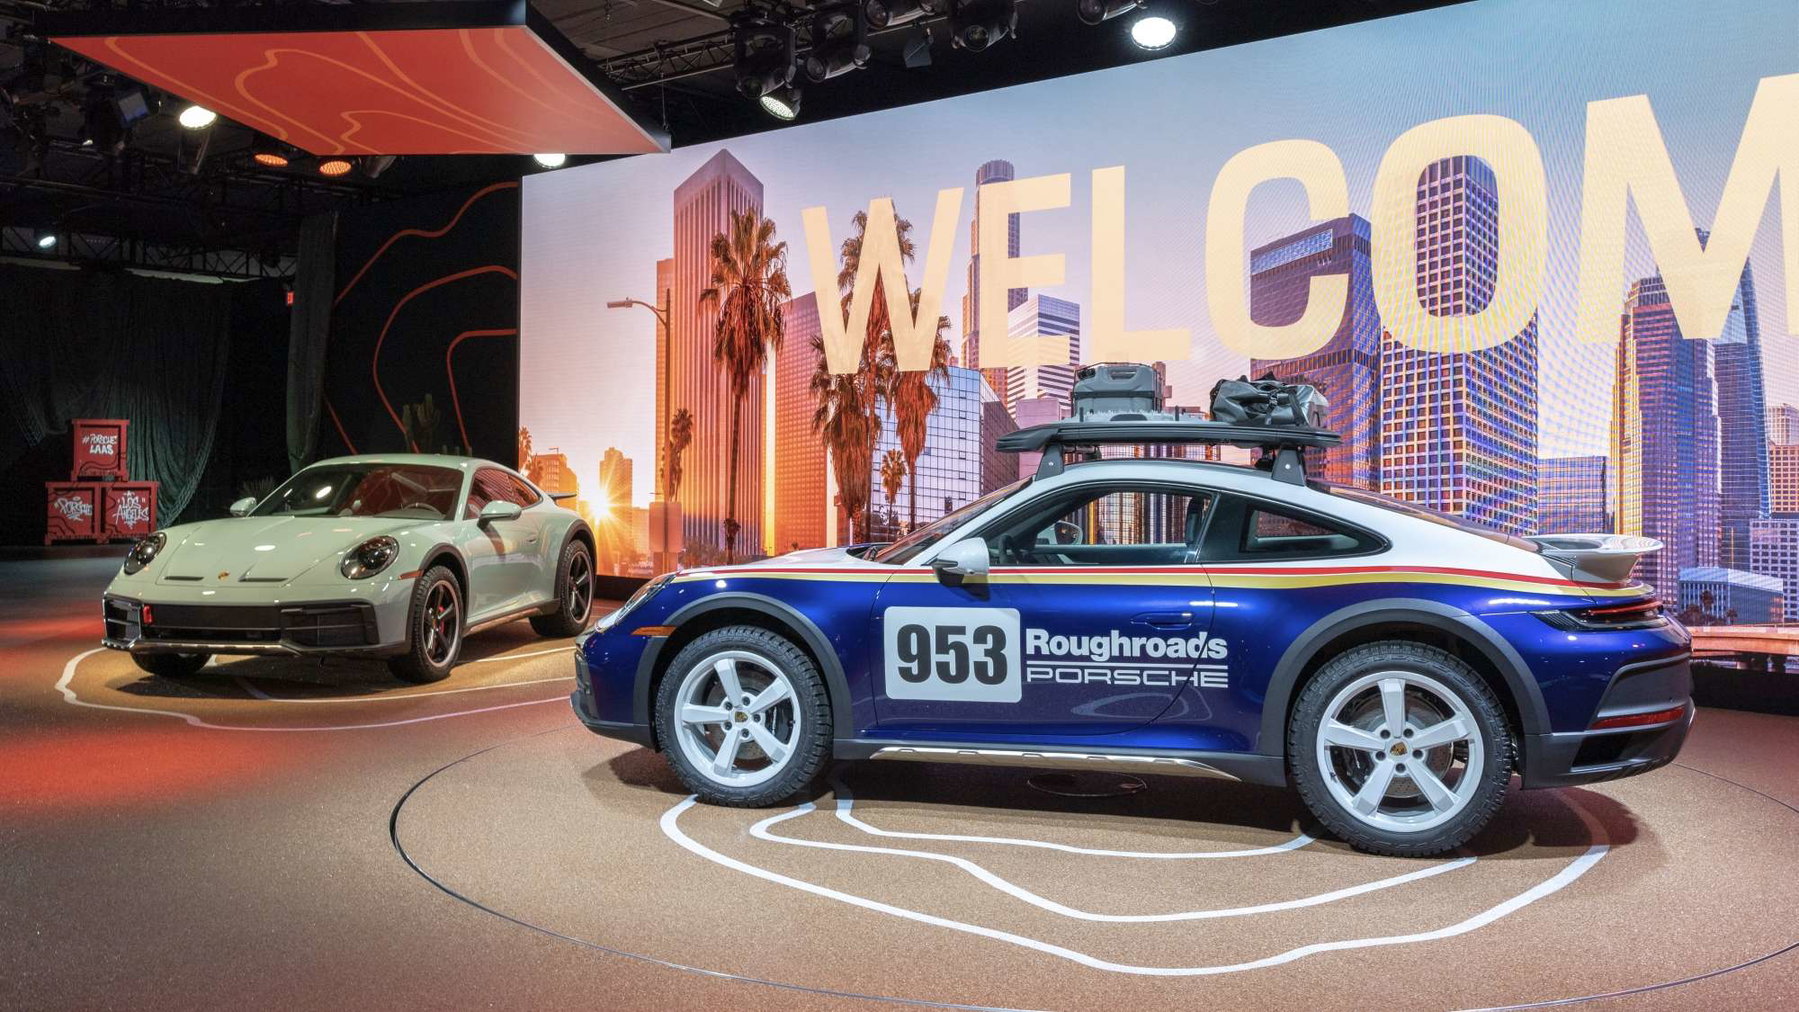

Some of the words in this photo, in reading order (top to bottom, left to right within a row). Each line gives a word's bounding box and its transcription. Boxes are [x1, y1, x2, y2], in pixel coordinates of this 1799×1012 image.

[801, 73, 1799, 375] WELCOM
[90, 444, 114, 455] LAAS
[897, 624, 1008, 685] 953
[1026, 628, 1228, 662] Roughroads
[1026, 668, 1229, 688] PORSCHE
